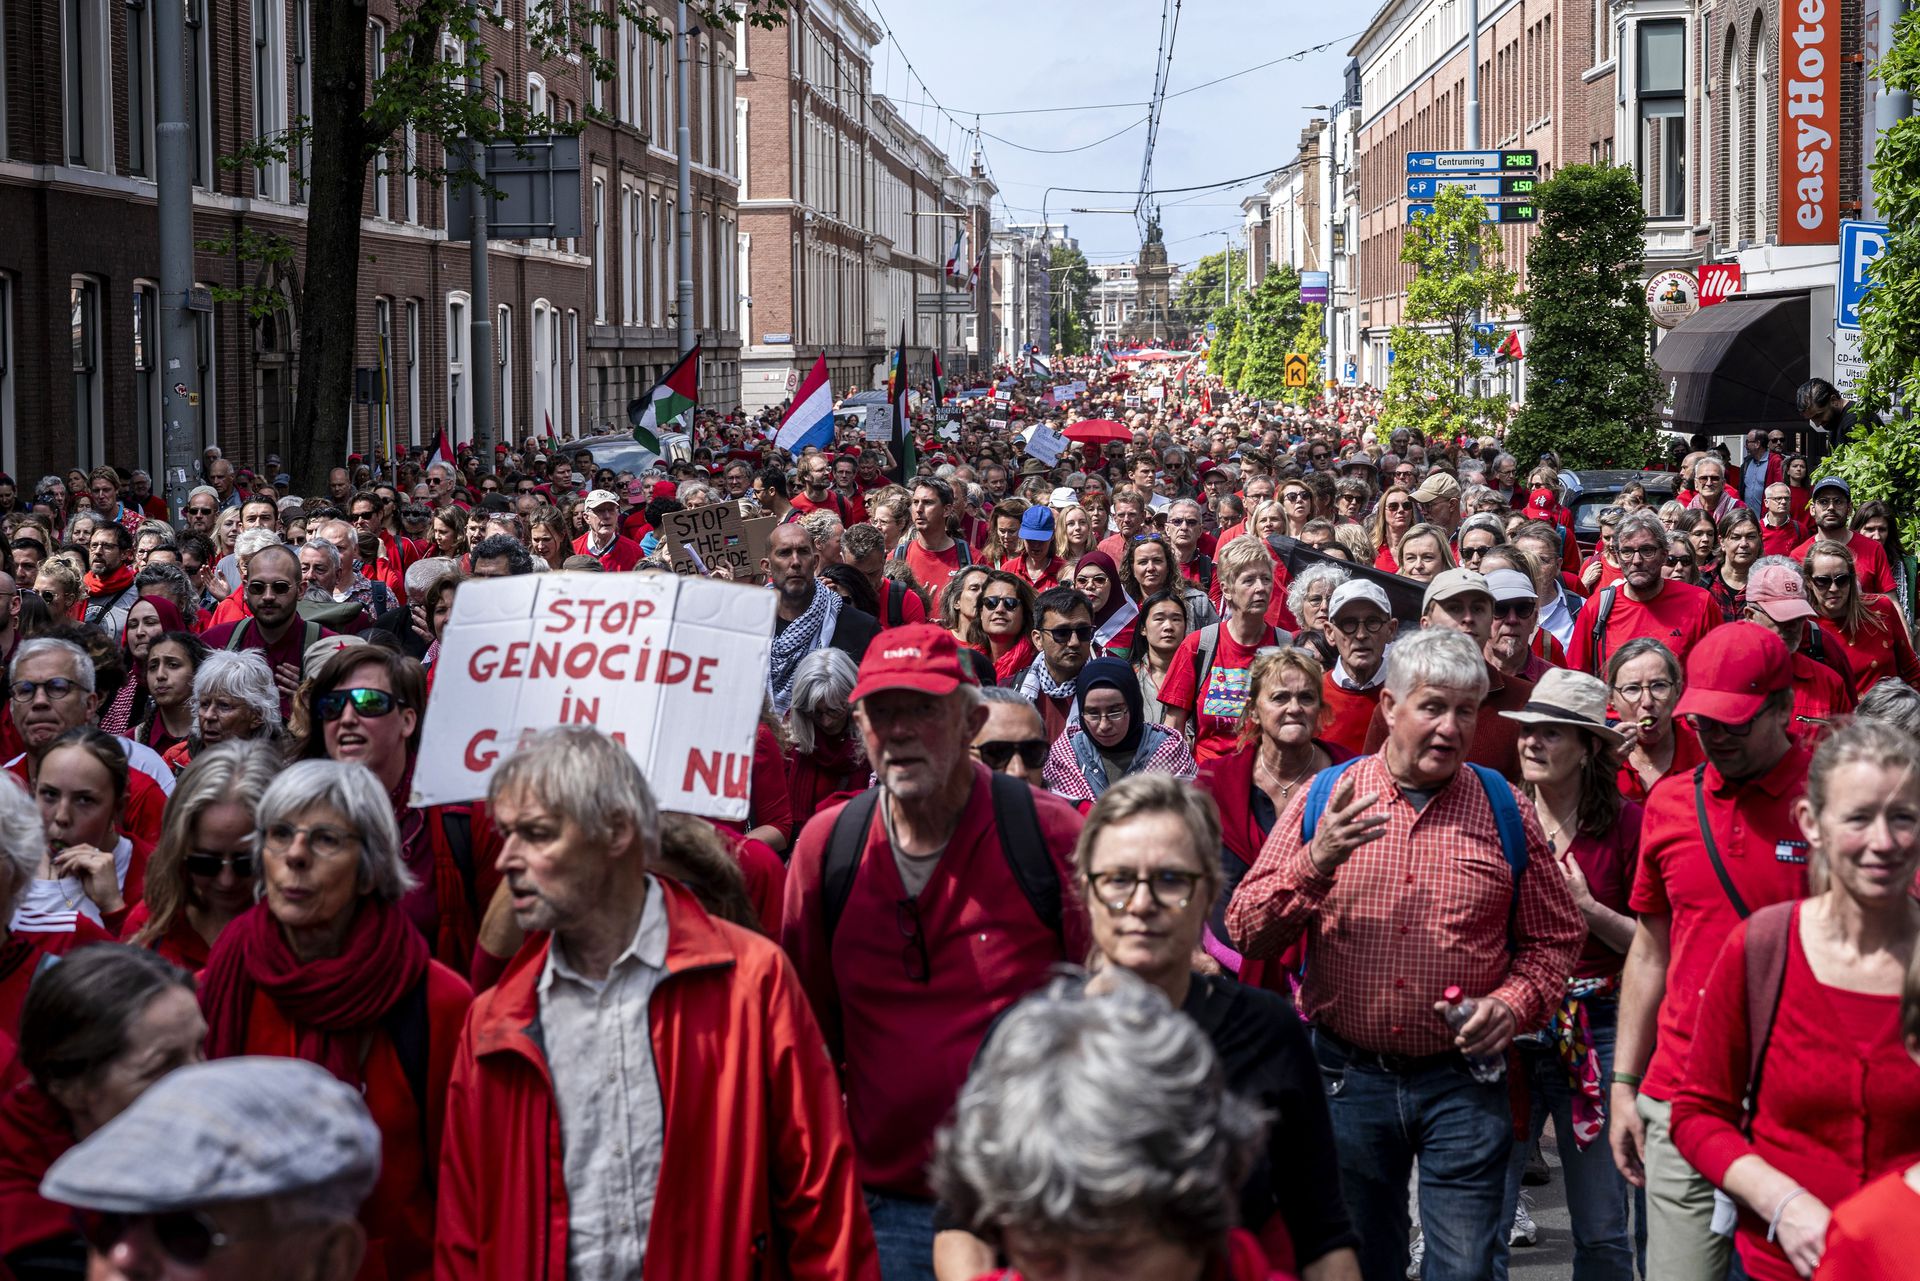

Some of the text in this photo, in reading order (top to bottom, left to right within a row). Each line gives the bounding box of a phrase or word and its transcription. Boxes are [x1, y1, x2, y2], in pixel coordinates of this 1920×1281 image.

[1438, 157, 1485, 167] Centrumring
[1506, 155, 1532, 166] 2483
[1512, 181, 1532, 192] 150
[1518, 207, 1532, 217] 44
[1647, 275, 1668, 303] BIRRA
[1701, 269, 1739, 303] illy
[1657, 304, 1692, 313] L'AUTENTICA
[1290, 368, 1302, 382] K
[673, 507, 729, 537] STOP
[545, 599, 655, 635] STOP
[682, 747, 750, 800] NU
